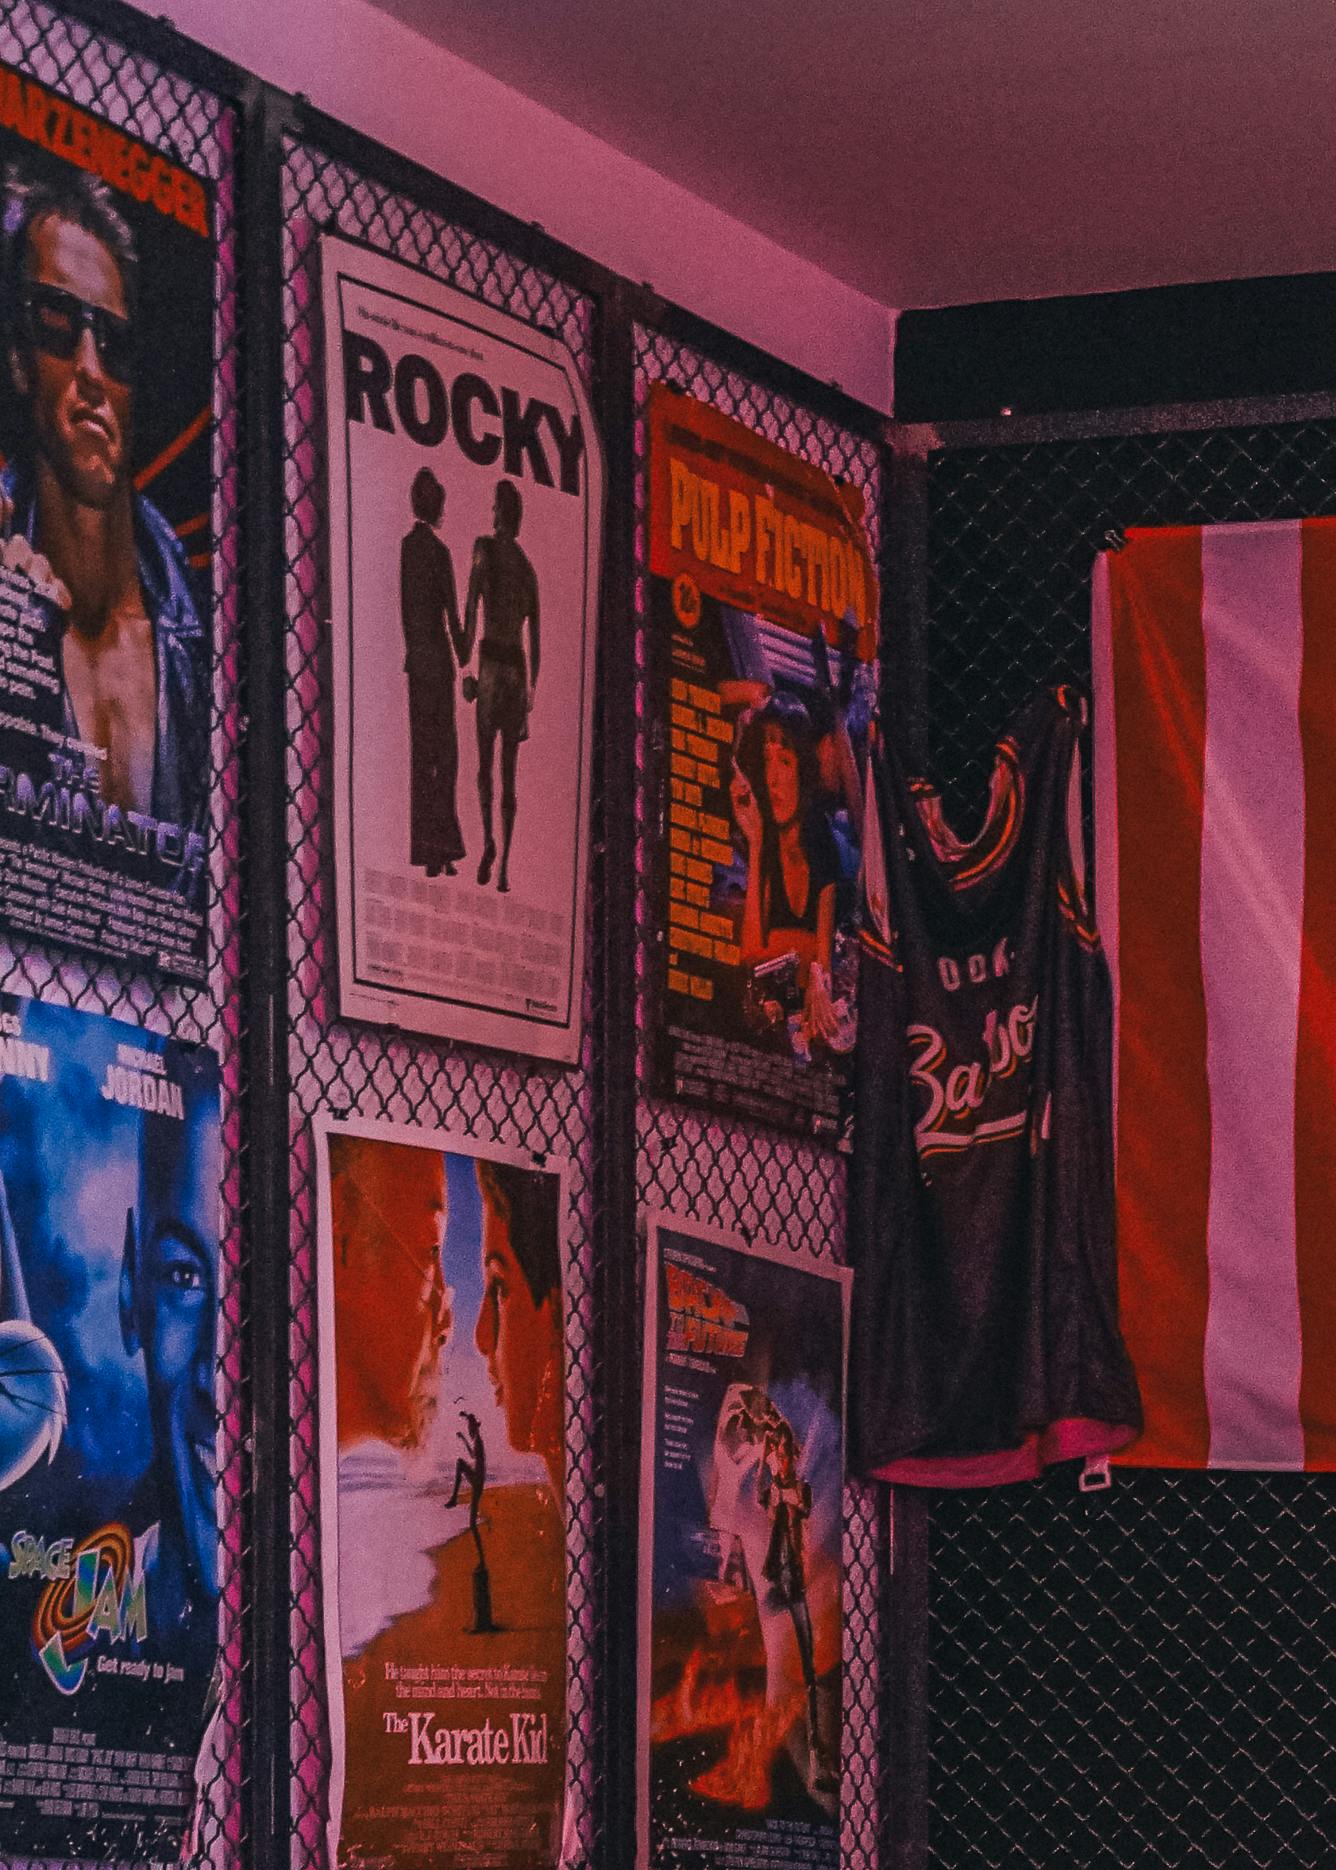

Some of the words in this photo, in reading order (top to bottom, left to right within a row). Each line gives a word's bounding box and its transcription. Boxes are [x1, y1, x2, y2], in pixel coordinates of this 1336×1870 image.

[344, 329, 586, 496] ROCKY
[670, 457, 750, 574] PULP
[755, 494, 866, 628] FICTION
[8, 1529, 75, 1581] SPACE
[38, 1520, 161, 1696] JAM
[96, 1655, 118, 1674] Get
[120, 1659, 151, 1681] ready
[152, 1663, 164, 1679] to
[383, 1712, 409, 1733] The
[408, 1711, 510, 1765] Karate
[509, 1712, 548, 1764] Kid
